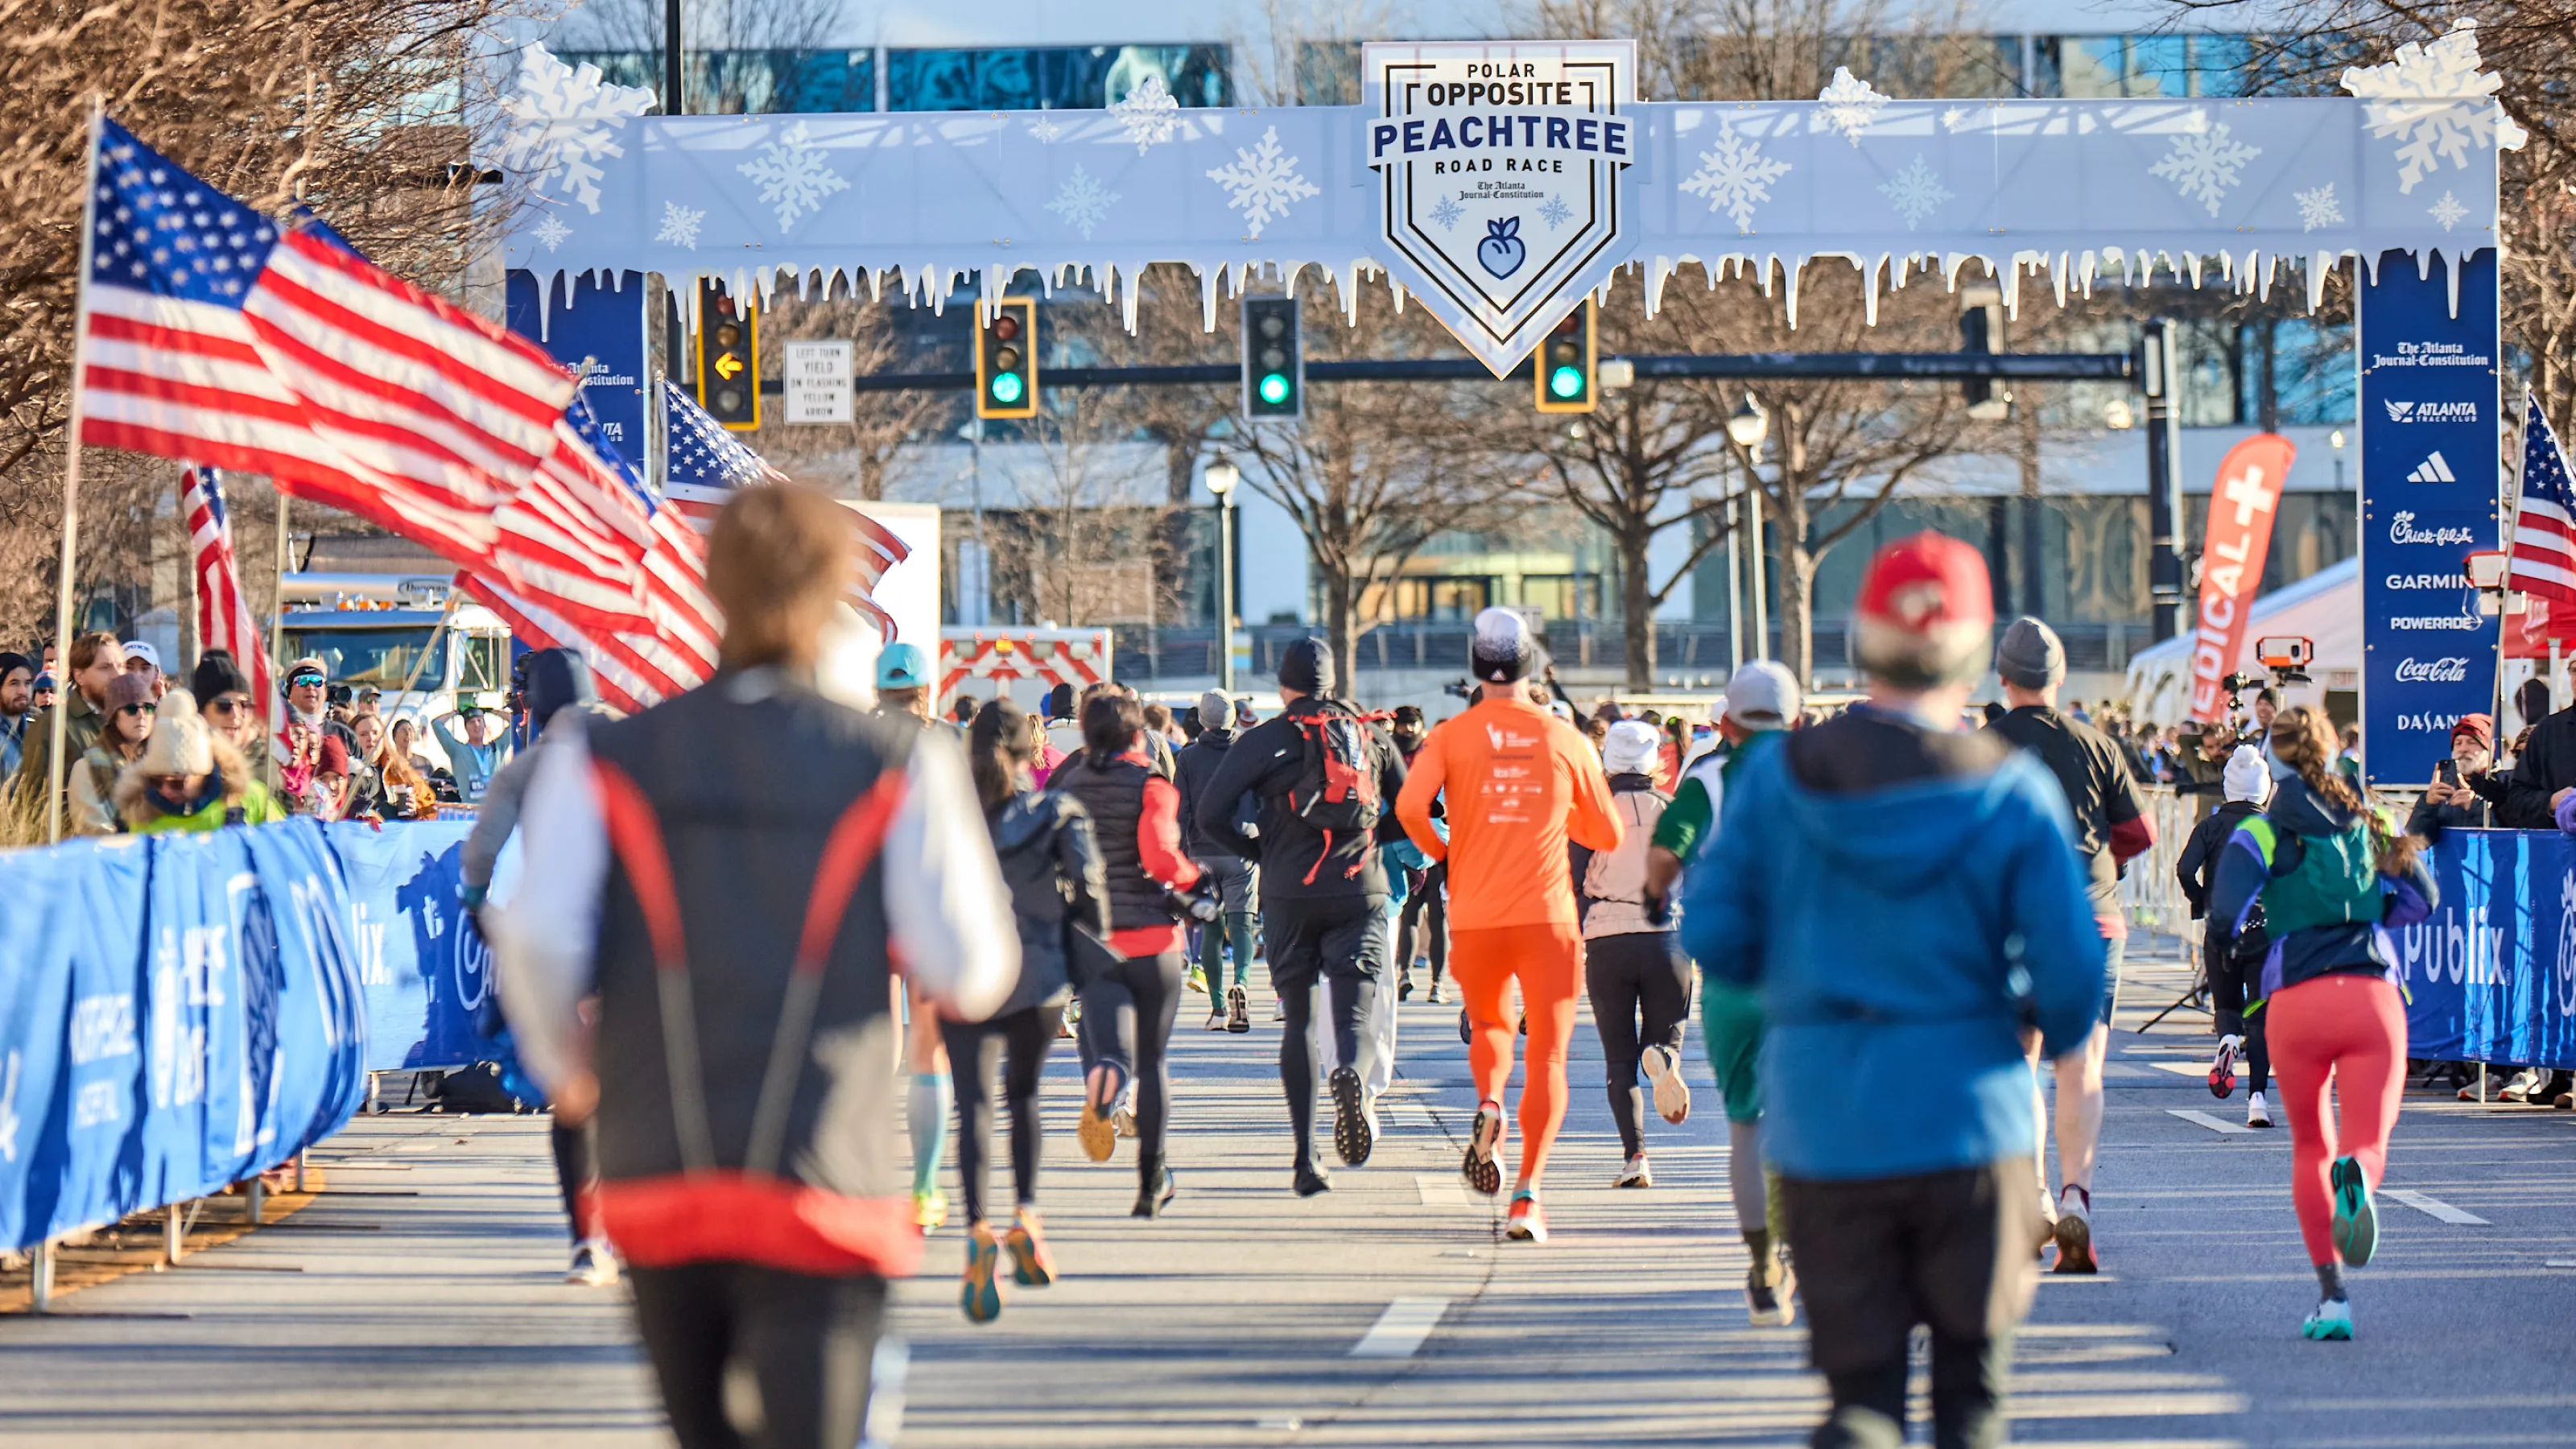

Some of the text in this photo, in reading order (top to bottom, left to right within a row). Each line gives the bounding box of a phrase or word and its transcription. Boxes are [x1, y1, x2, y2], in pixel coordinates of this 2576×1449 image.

[1468, 64, 1534, 78] POLAR
[1427, 81, 1572, 106] OPPOSITE
[1374, 115, 1626, 157] PEACHTREE
[1435, 158, 1563, 175] ROAD RACE
[1477, 180, 1525, 192] The Atlanta
[1458, 190, 1544, 200] Journal-Constitution
[796, 348, 840, 358] LEFT TURN
[2397, 341, 2463, 355] The Atlanta
[803, 361, 833, 374] YIELD
[2372, 354, 2488, 369] Journal-Constitution
[791, 378, 847, 388] ON FLASHING
[803, 393, 834, 402] YELLOW
[805, 407, 832, 416] ARROW
[2416, 402, 2477, 416] ATLANTA
[2390, 512, 2474, 547] Chick-fil-A
[2191, 531, 2251, 718] EDICAL
[2390, 617, 2471, 630] POWERADE
[2395, 657, 2469, 683] Coca-Cola
[2397, 710, 2464, 733] DASAN
[2405, 906, 2506, 985] Publix
